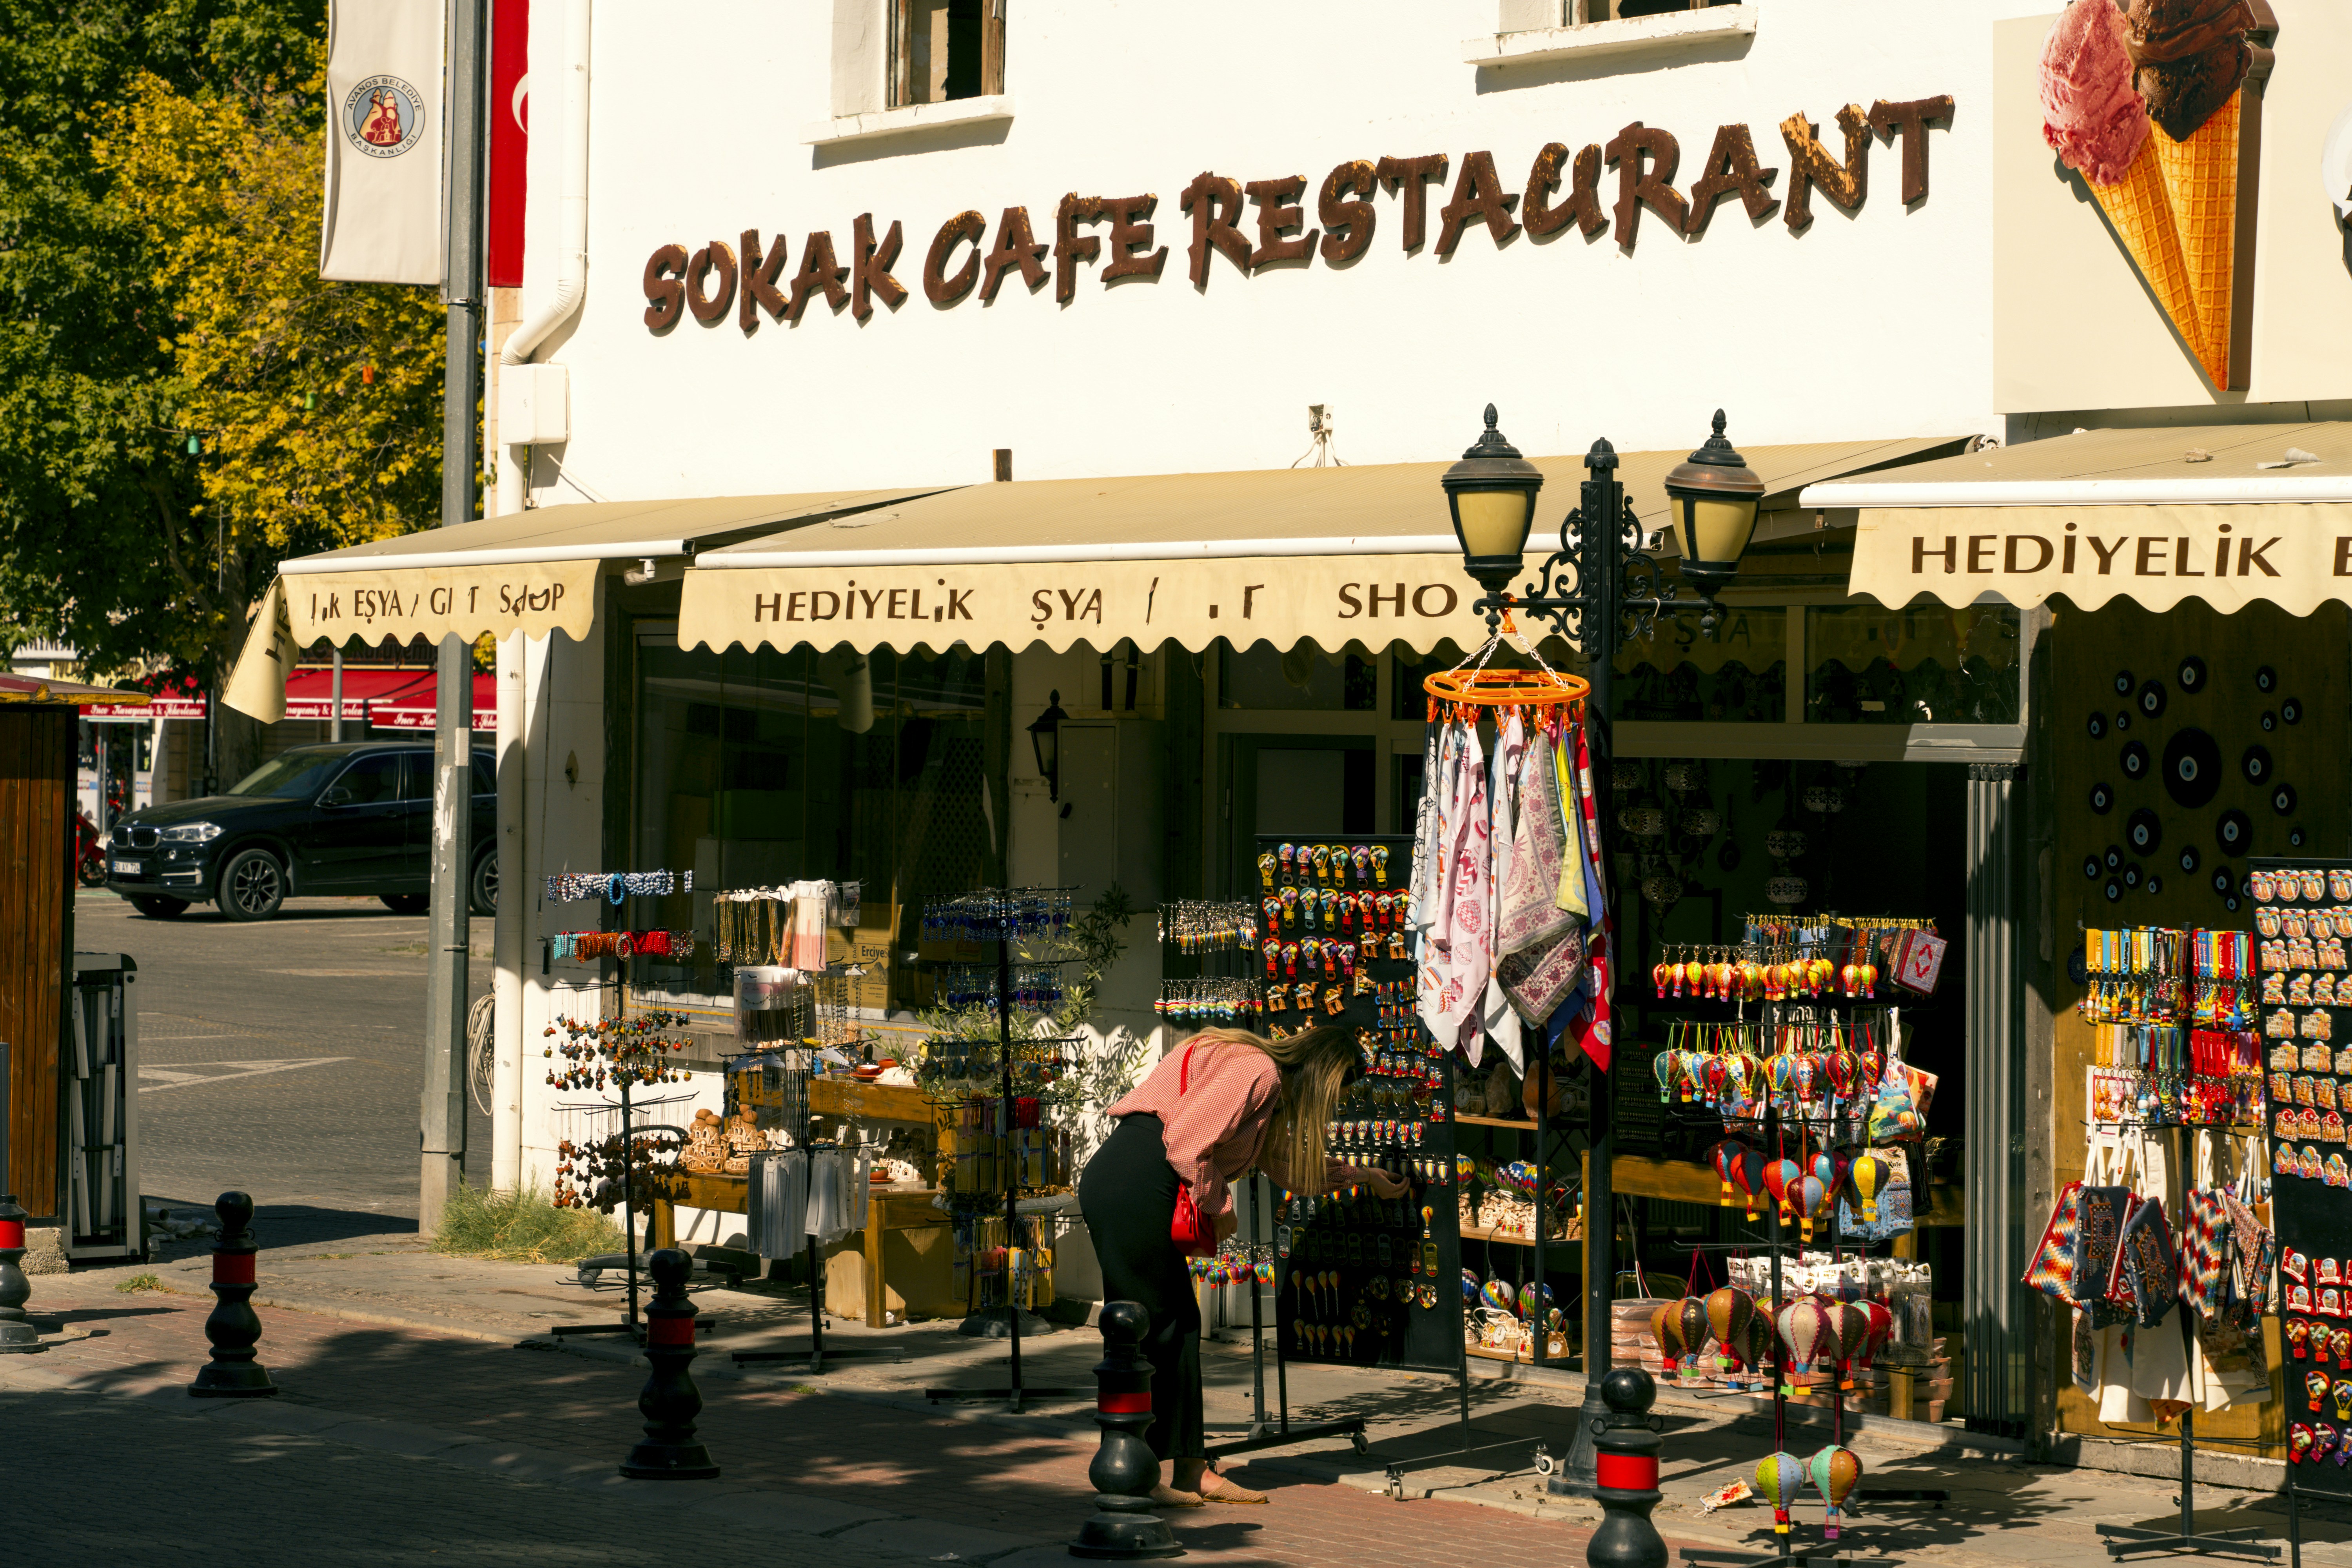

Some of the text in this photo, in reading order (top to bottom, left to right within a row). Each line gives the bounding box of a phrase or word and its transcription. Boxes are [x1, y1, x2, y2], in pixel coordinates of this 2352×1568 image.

[348, 78, 422, 111] AVANOS BELEDİYE
[351, 133, 416, 155] BAŞKANLIĞI
[643, 94, 1956, 334] SOKAK CAFE RESTAURANT
[1912, 522, 2283, 578] HEDİYELİK
[354, 589, 403, 624] EŞYA
[1878, 1121, 1914, 1132] Cappadocia
